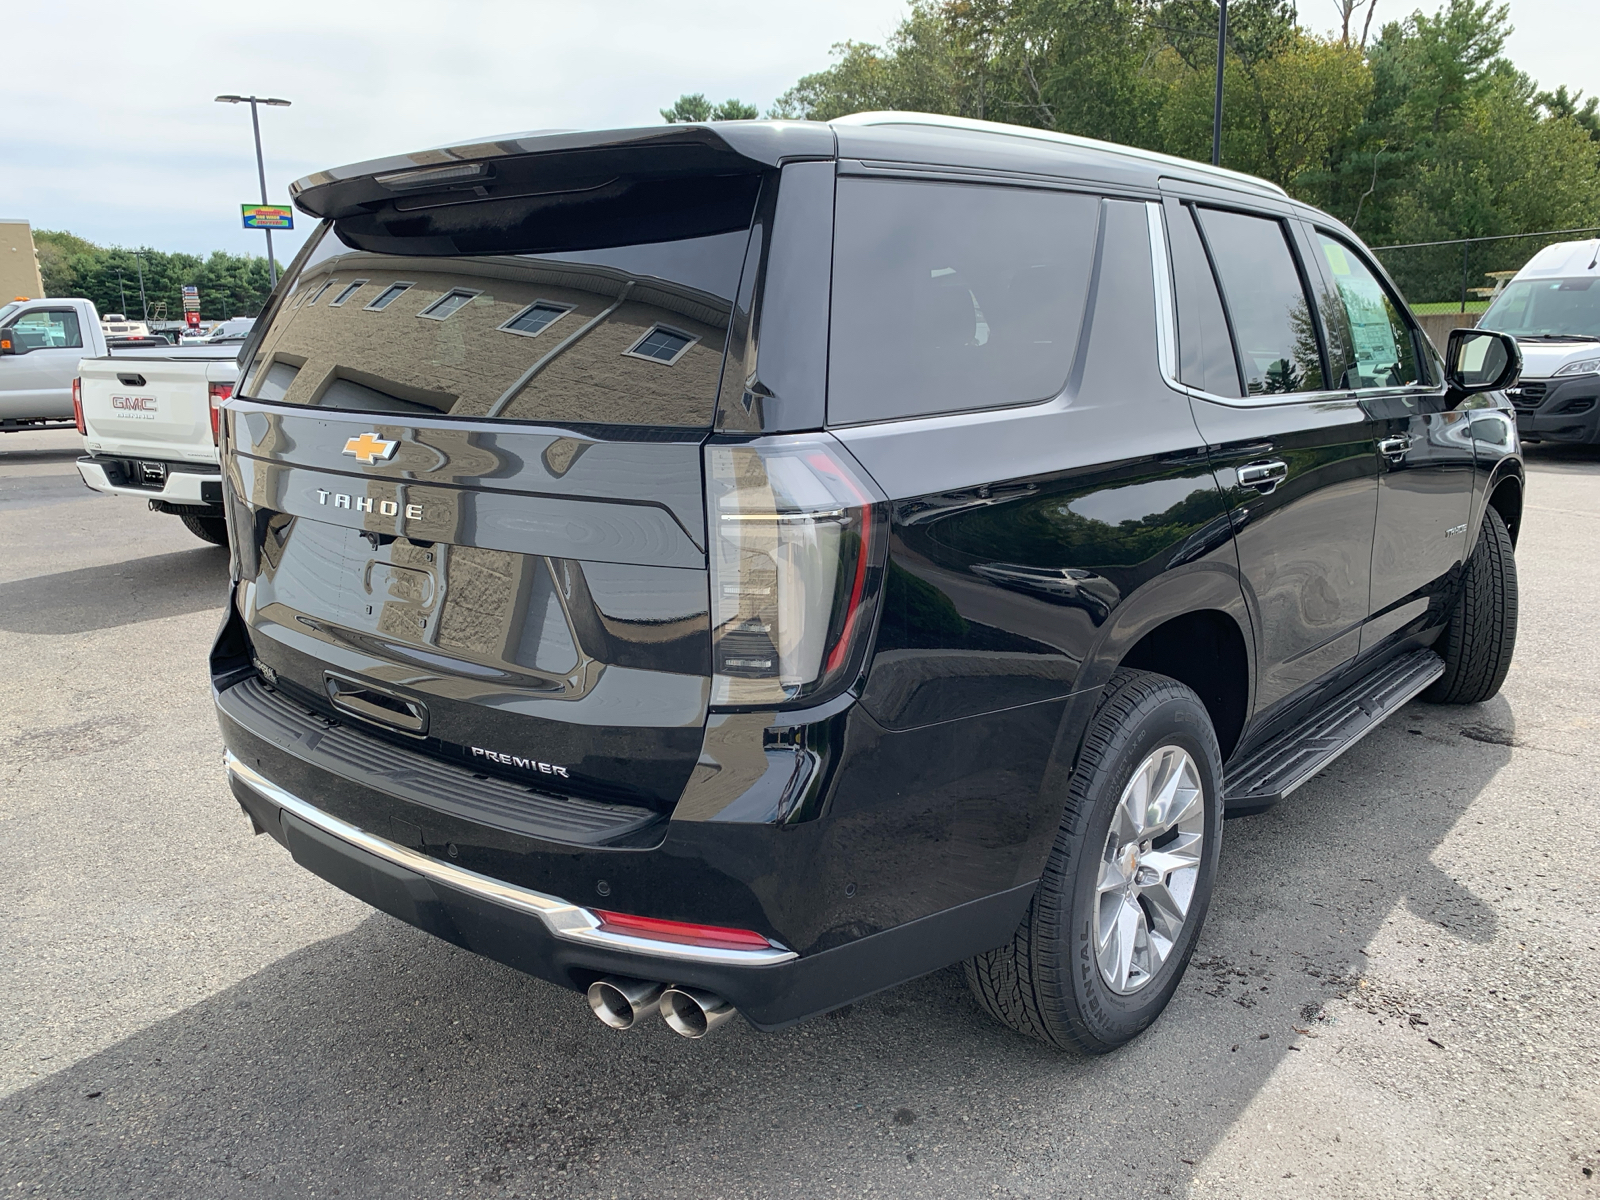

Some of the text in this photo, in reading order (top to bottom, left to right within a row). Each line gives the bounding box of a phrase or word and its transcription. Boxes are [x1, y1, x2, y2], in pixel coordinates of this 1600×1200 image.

[112, 396, 157, 411] GMC
[316, 488, 424, 521] TAHOE
[471, 746, 570, 779] PREMIER
